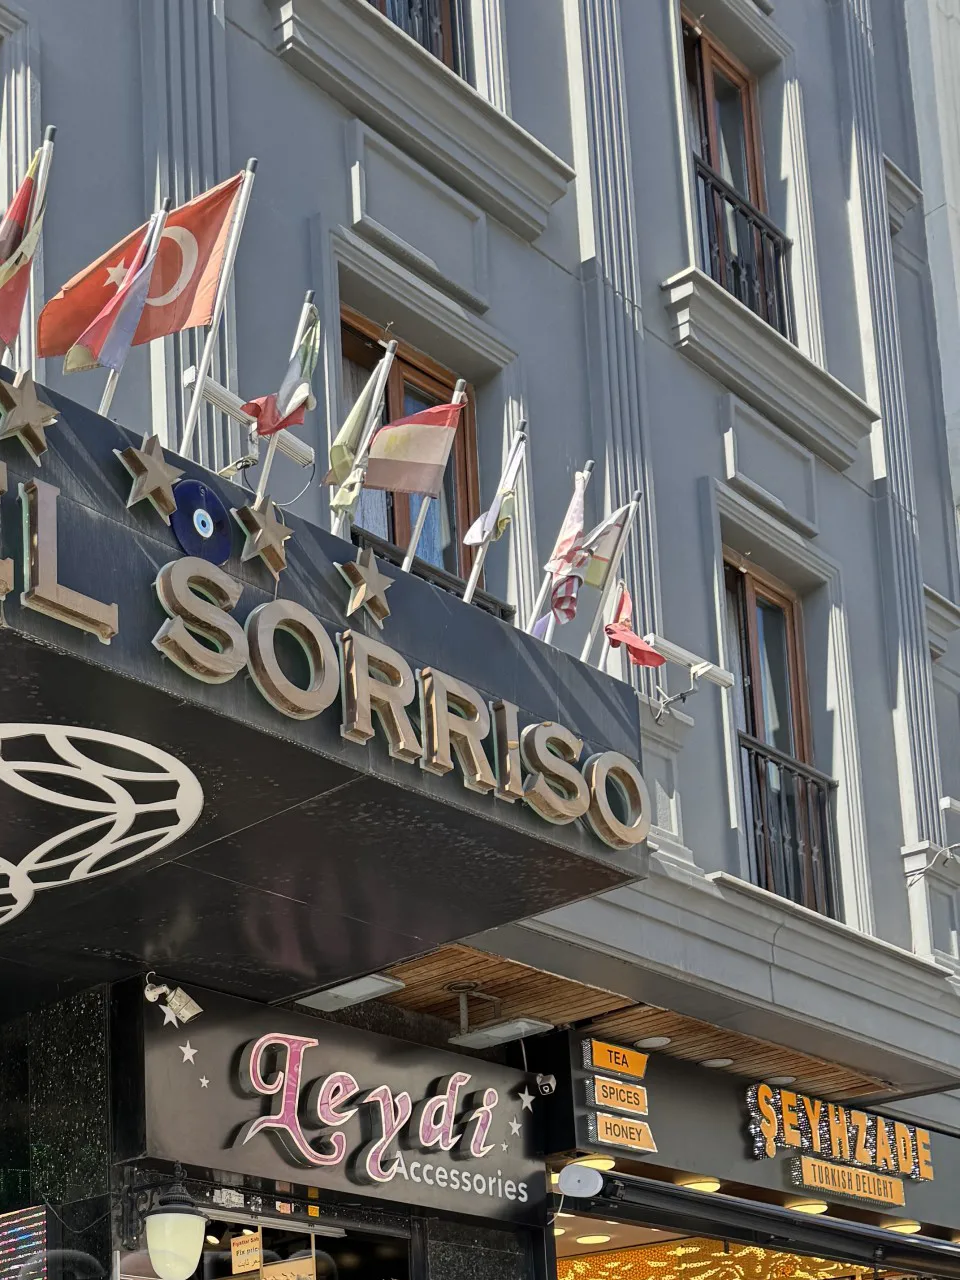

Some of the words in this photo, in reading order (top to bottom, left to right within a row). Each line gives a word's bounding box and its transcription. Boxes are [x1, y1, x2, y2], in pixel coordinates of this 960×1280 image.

[151, 556, 652, 851] SORRISO
[606, 1048, 630, 1069] TEA
[239, 1032, 500, 1183] Leydi
[600, 1084, 641, 1107] SPICES
[604, 1121, 643, 1143] HONEY
[752, 1083, 935, 1182] ŞEYHZADE
[393, 1150, 529, 1204] Accessories
[810, 1163, 854, 1190] TURKISH
[855, 1174, 894, 1200] DELIGHT
[246, 1247, 259, 1255] pric
